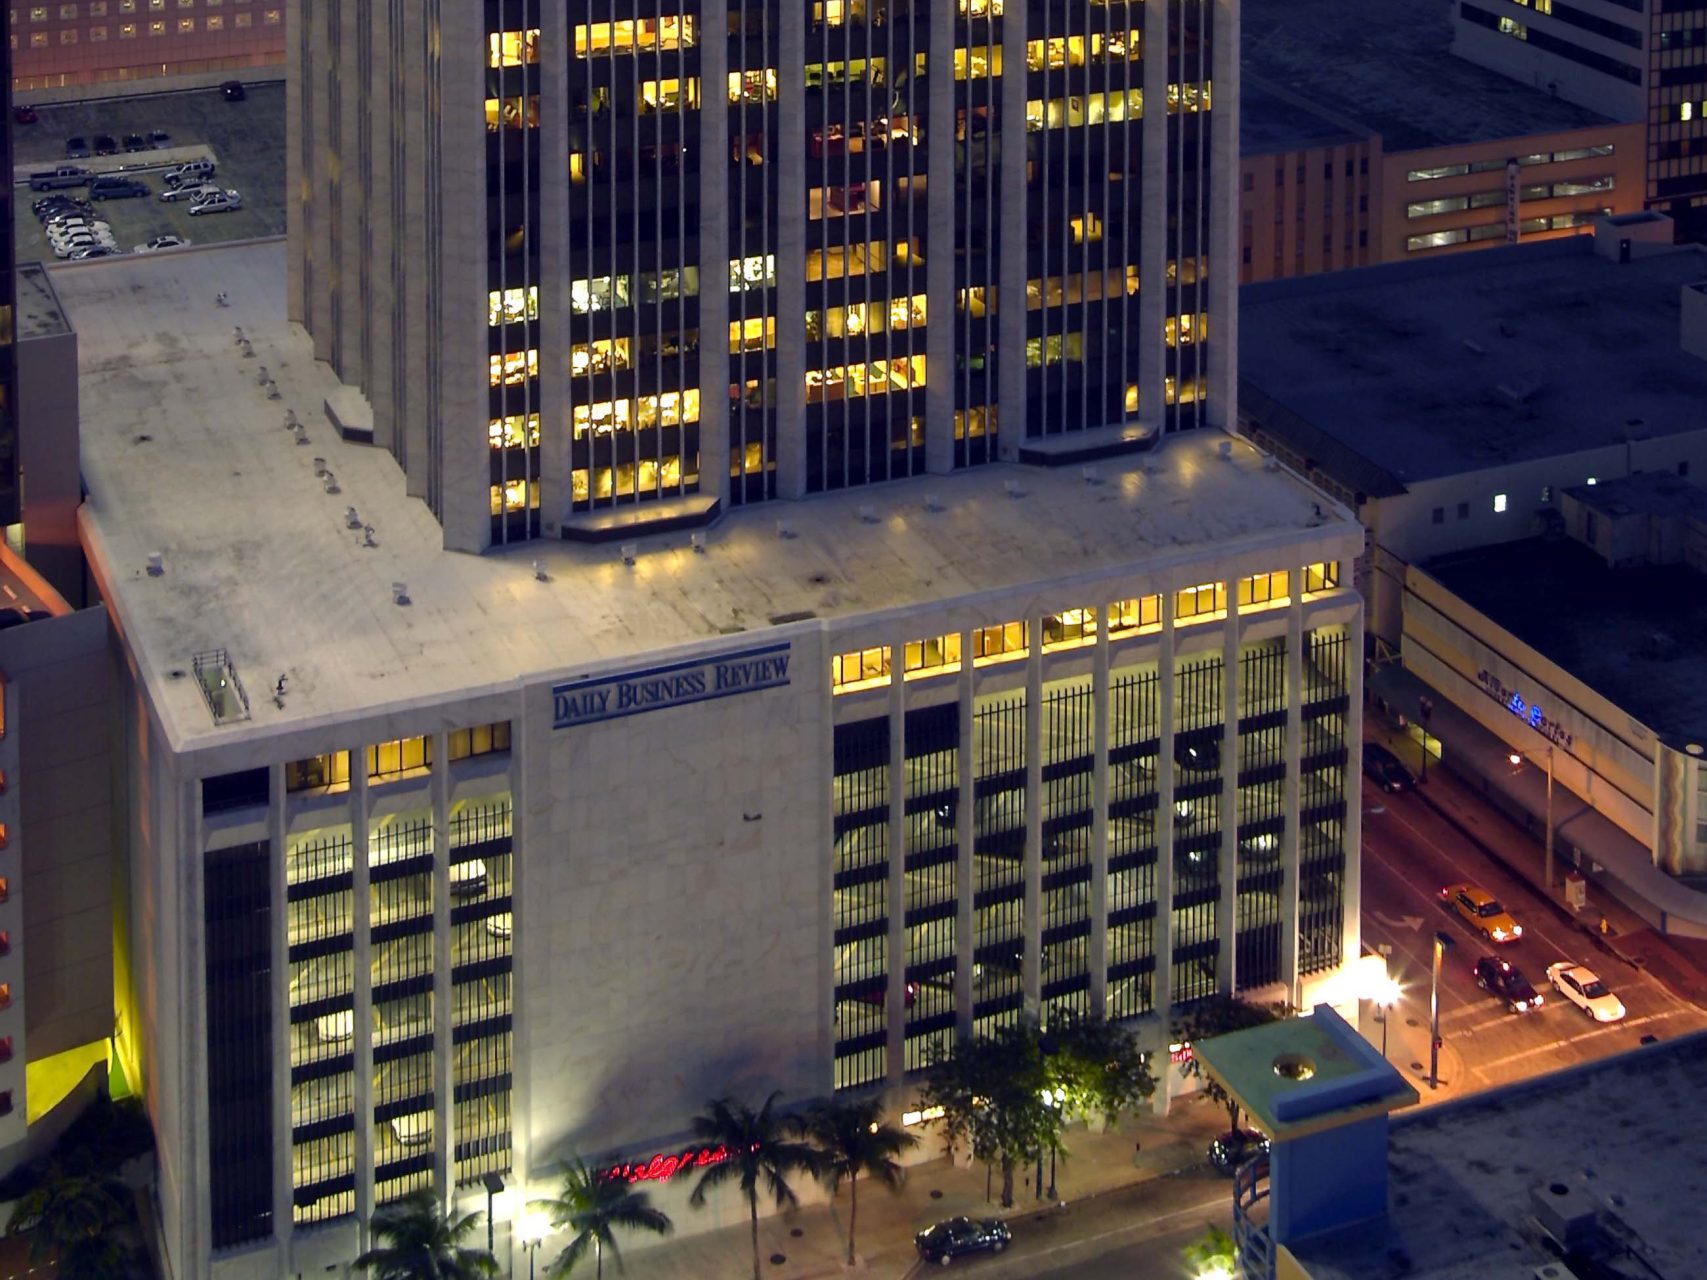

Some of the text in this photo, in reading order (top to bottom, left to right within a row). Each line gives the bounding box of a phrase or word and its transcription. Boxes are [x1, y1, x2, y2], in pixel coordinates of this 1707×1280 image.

[553, 655, 791, 720] DAILY BUSINESS REVIEW
